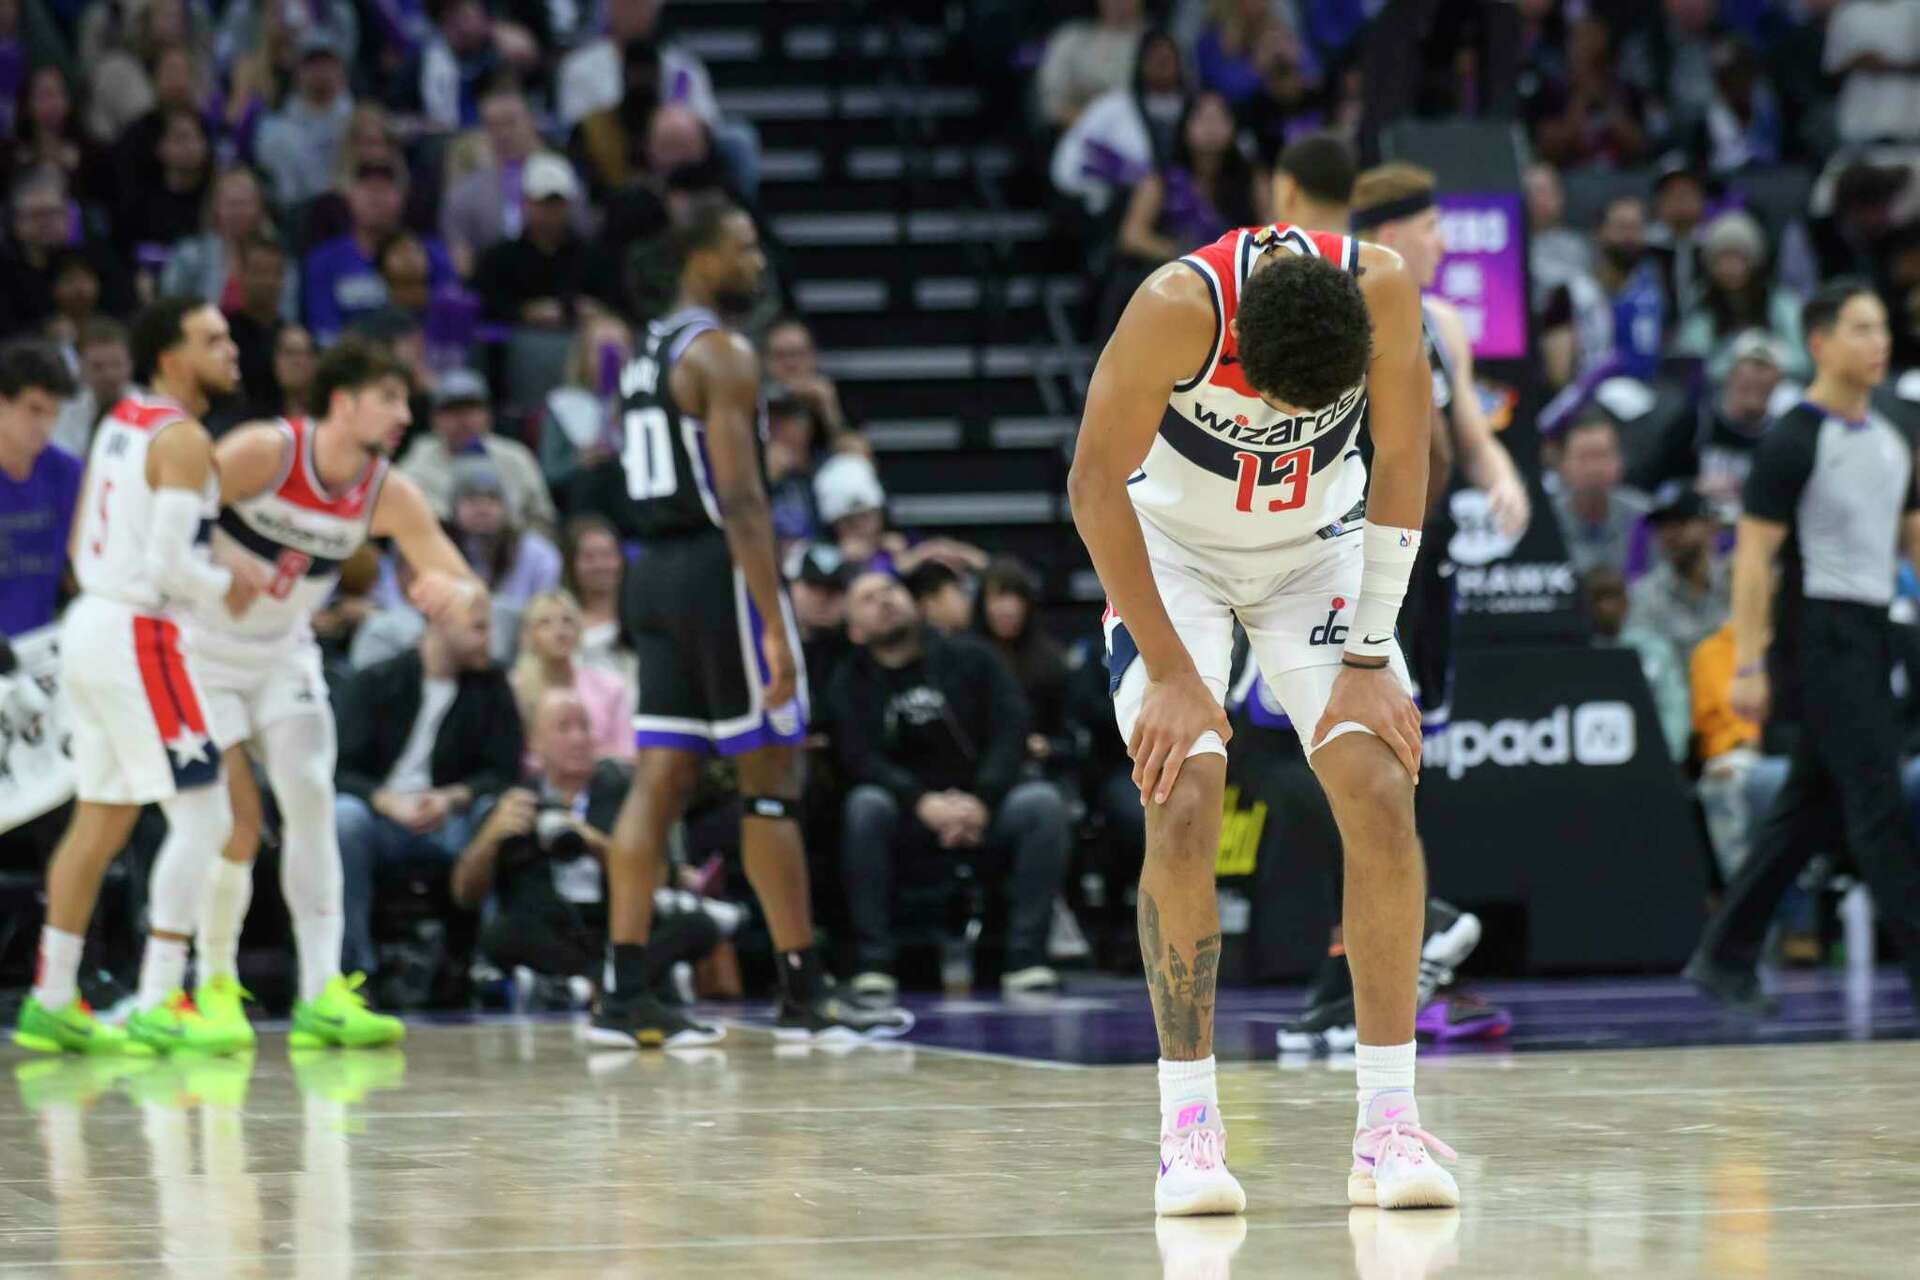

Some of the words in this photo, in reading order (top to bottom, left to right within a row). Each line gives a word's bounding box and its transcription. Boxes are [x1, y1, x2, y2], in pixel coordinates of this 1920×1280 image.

[1194, 386, 1357, 446] wizards
[1234, 447, 1313, 513] 13
[1309, 606, 1349, 646] dc
